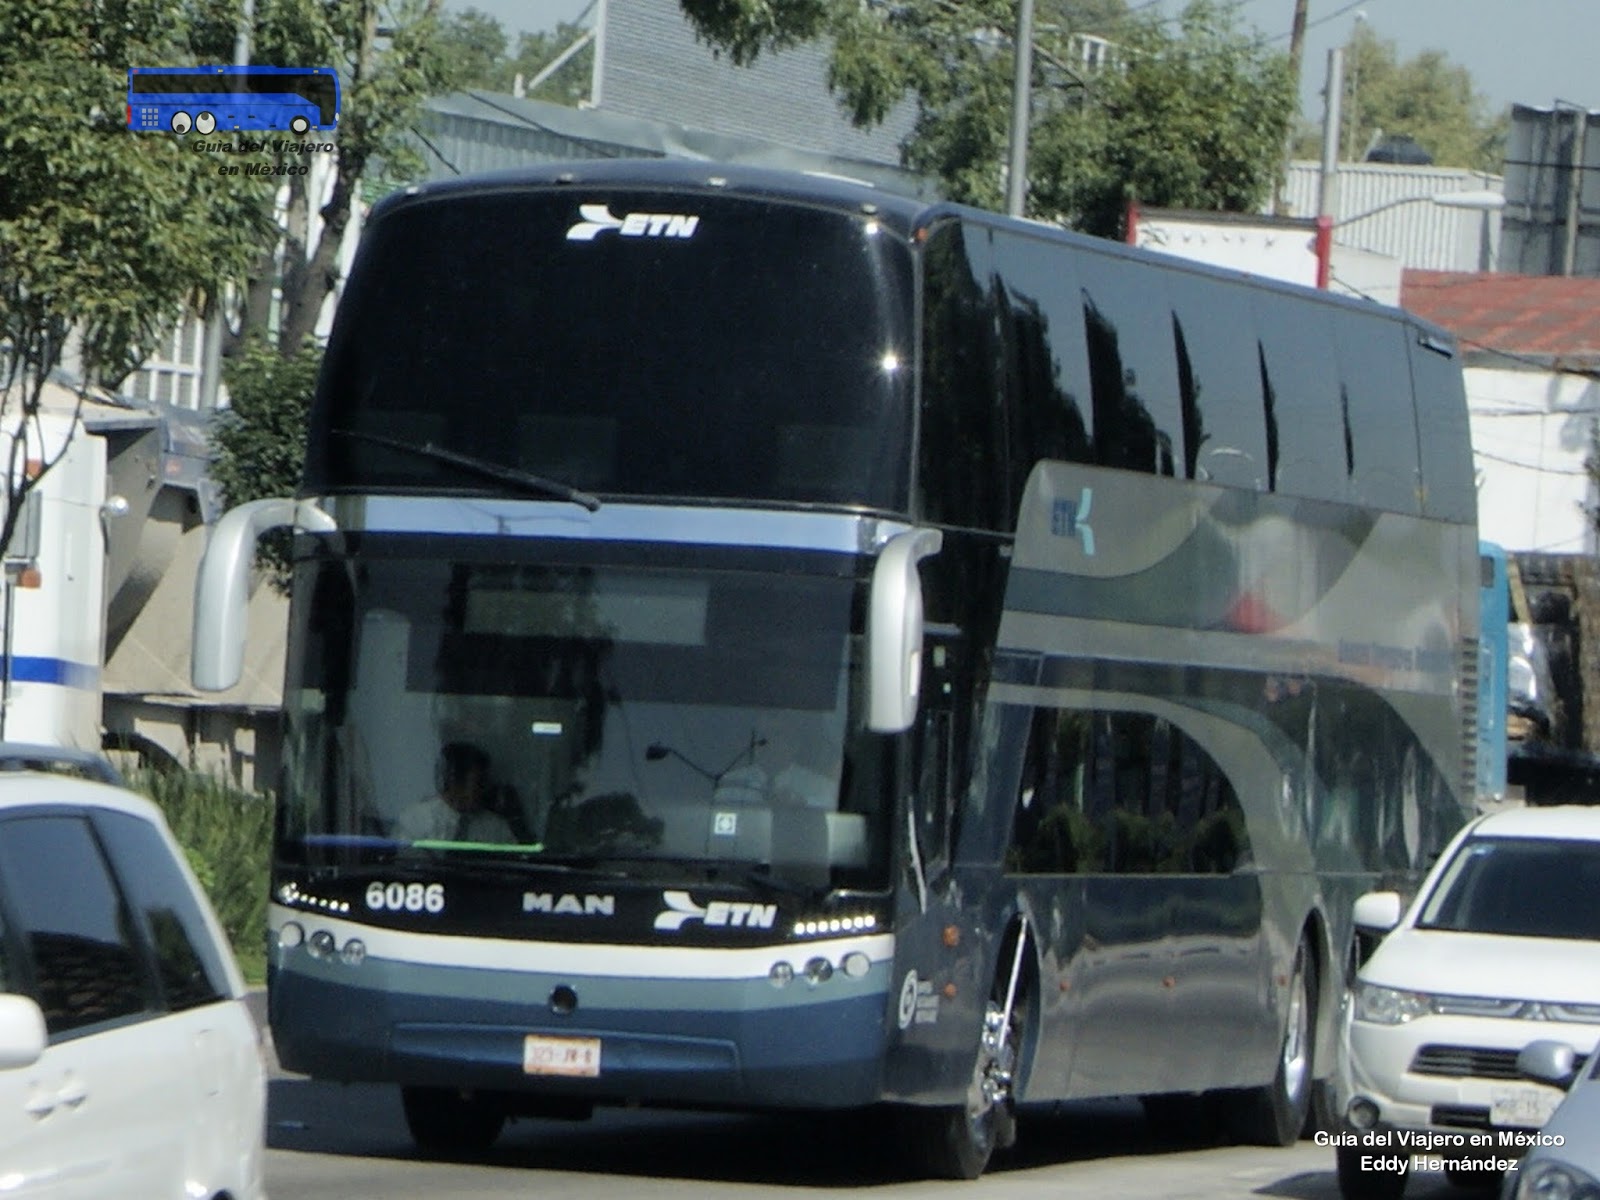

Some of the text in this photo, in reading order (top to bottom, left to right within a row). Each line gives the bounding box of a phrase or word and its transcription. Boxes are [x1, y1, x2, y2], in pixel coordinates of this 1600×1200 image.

[619, 212, 700, 238] ETN
[365, 882, 445, 913] 6086
[522, 892, 615, 915] MAN
[703, 901, 778, 928] ETN
